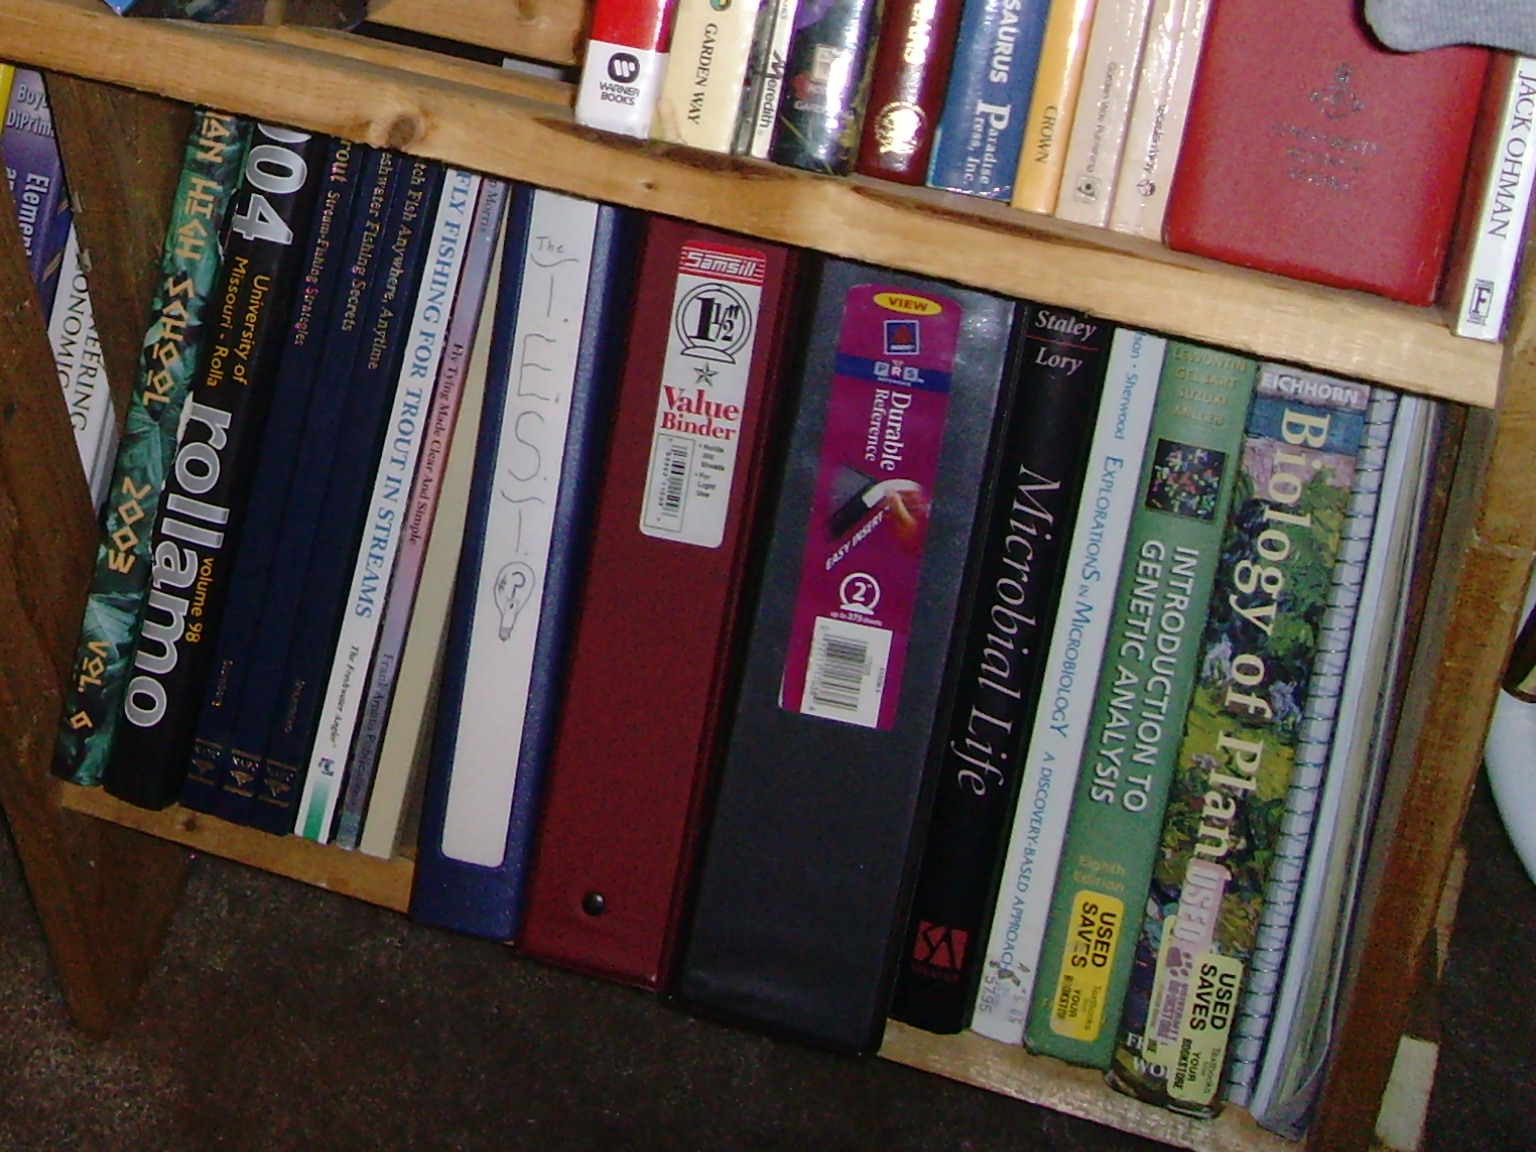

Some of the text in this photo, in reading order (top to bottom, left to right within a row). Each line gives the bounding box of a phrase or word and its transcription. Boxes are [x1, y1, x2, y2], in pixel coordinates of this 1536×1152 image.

[600, 81, 640, 96] WARNER
[601, 91, 635, 106] BOOKS
[687, 22, 719, 125] GARDEN WAY
[1034, 106, 1058, 164] CROWN
[174, 176, 218, 262] HIGH
[535, 235, 565, 256] The
[686, 251, 757, 278] Samsill
[231, 274, 272, 385] University of
[888, 296, 929, 312] VIEW
[1034, 309, 1098, 342] Staley
[142, 276, 195, 408] SCHOOL
[1034, 346, 1084, 376] Lory
[355, 172, 473, 619] FLY FISHING FOR TROUT IN STREAMS
[663, 384, 741, 422] Value
[1114, 372, 1139, 441] Sherwood
[1175, 368, 1238, 387] GELBART
[1177, 388, 1229, 406] SUZUKI
[1260, 371, 1359, 404] EICHHORN
[408, 342, 464, 546] Fly Tying Made Clear And Simple
[659, 410, 737, 441] Binder
[864, 388, 891, 462] Reference
[879, 390, 913, 472] Durable
[1174, 406, 1224, 427] MILLER
[107, 475, 152, 575] 2003
[125, 401, 233, 728] rollamo
[1224, 408, 1331, 726] Biology of
[185, 557, 215, 644] volume 98
[950, 463, 1062, 798] Microbial Life
[1090, 539, 1166, 807] GENETIC ANALYSIS
[1123, 546, 1200, 812] INTRODUCTION TO
[1091, 911, 1118, 969] USED
[1189, 963, 1217, 1032] SAVES
[1210, 972, 1237, 1031] USED
